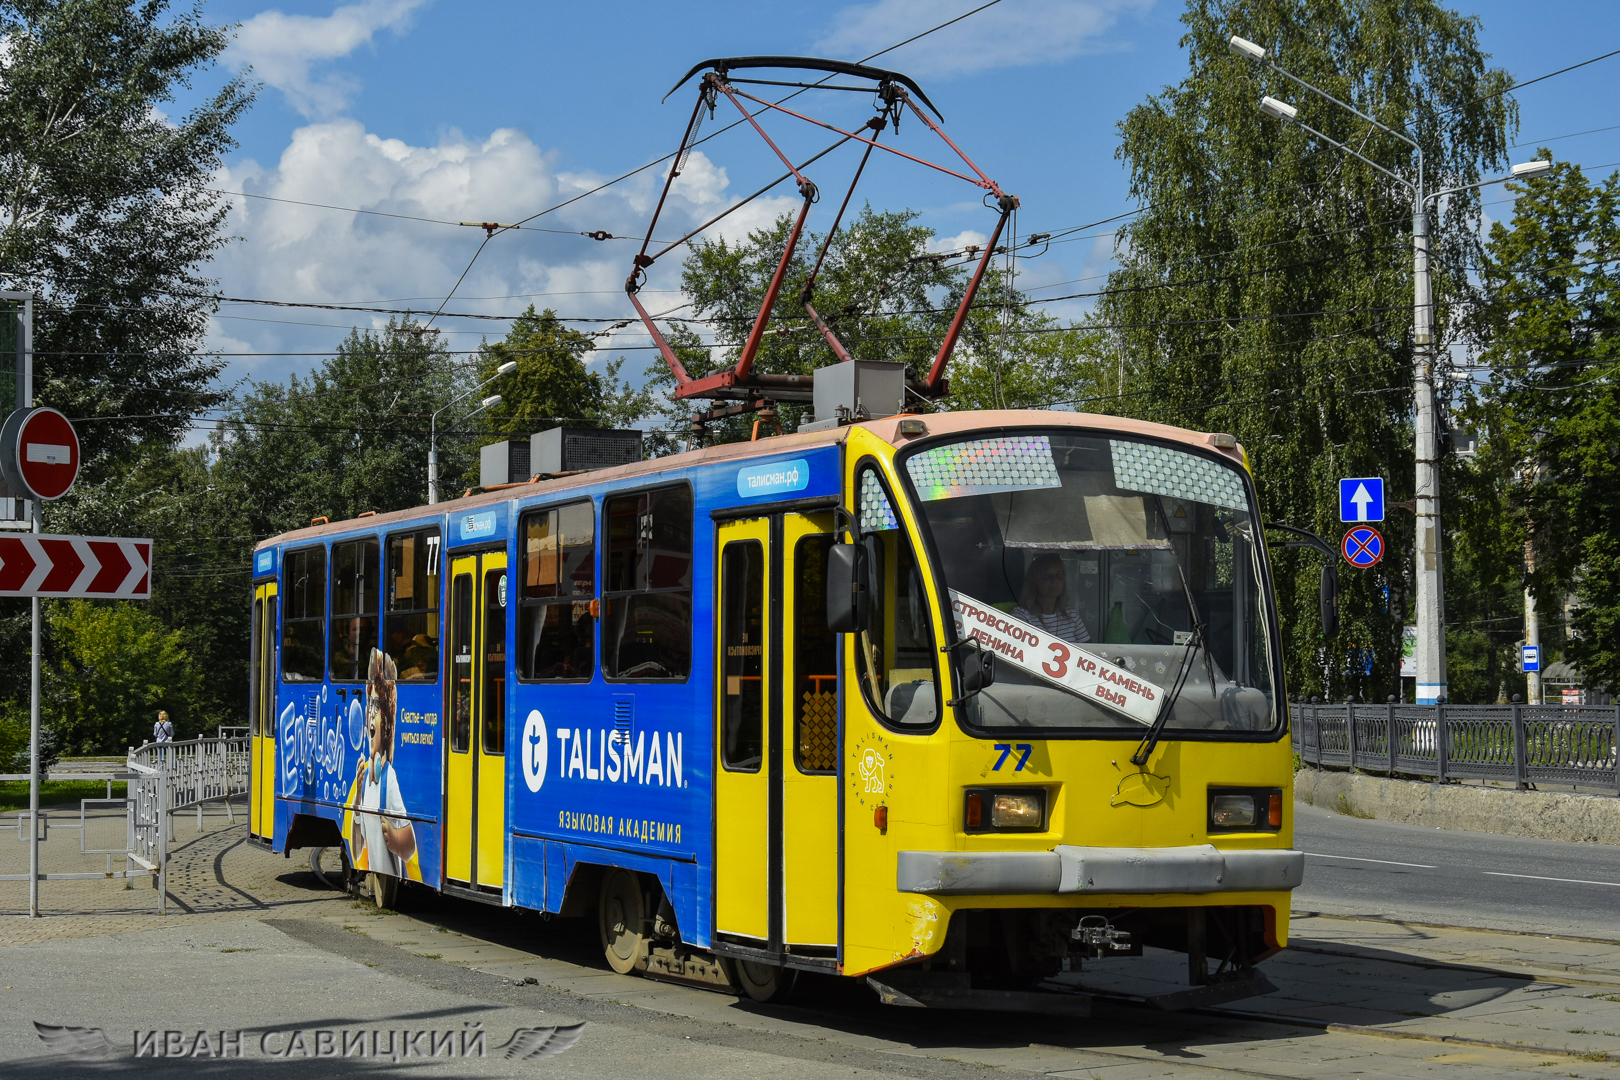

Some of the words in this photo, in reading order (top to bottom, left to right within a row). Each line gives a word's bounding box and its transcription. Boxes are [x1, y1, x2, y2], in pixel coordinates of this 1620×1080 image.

[747, 466, 799, 488] талисман.рф
[427, 536, 440, 576] 77
[950, 598, 1040, 648] СТРОВСКОГО
[954, 620, 963, 635] Р.
[967, 627, 1024, 662] ЛЕНИНА
[1042, 642, 1071, 679] 3
[1076, 656, 1097, 676] КР.
[1098, 667, 1155, 701] КАМЕНЬ
[1095, 685, 1127, 708] ВЫЯ
[401, 708, 419, 723] Счастье
[424, 713, 437, 726] когда
[401, 732, 419, 747] учиться
[420, 730, 433, 745] легко!
[852, 732, 893, 760] TALISMAN
[556, 727, 683, 789] TALISMAN
[991, 743, 1033, 772] 77
[558, 810, 614, 835] ЯЗЫКОВАЯ
[618, 817, 682, 844] АКАДЕМИЯ
